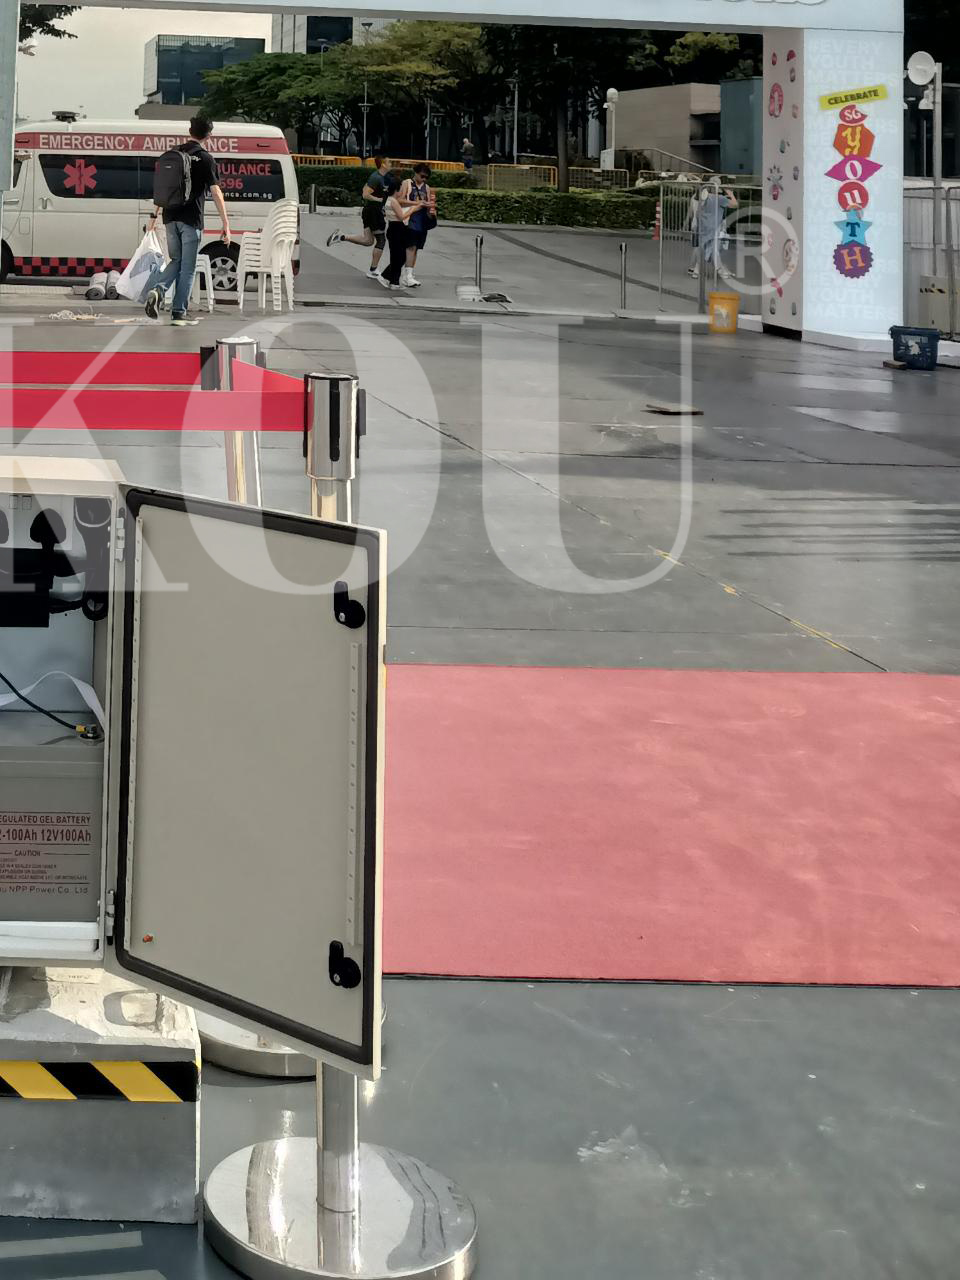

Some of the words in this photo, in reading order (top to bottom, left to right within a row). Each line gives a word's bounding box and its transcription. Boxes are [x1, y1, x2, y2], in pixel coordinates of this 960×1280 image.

[827, 89, 879, 106] CELEBRATE
[40, 134, 135, 151] EMERGENCY
[40, 815, 55, 824] GEL
[56, 815, 91, 825] BATTERY
[41, 828, 92, 842] 12V100Ah
[14, 849, 41, 857] CAUTION
[29, 885, 55, 894] Power
